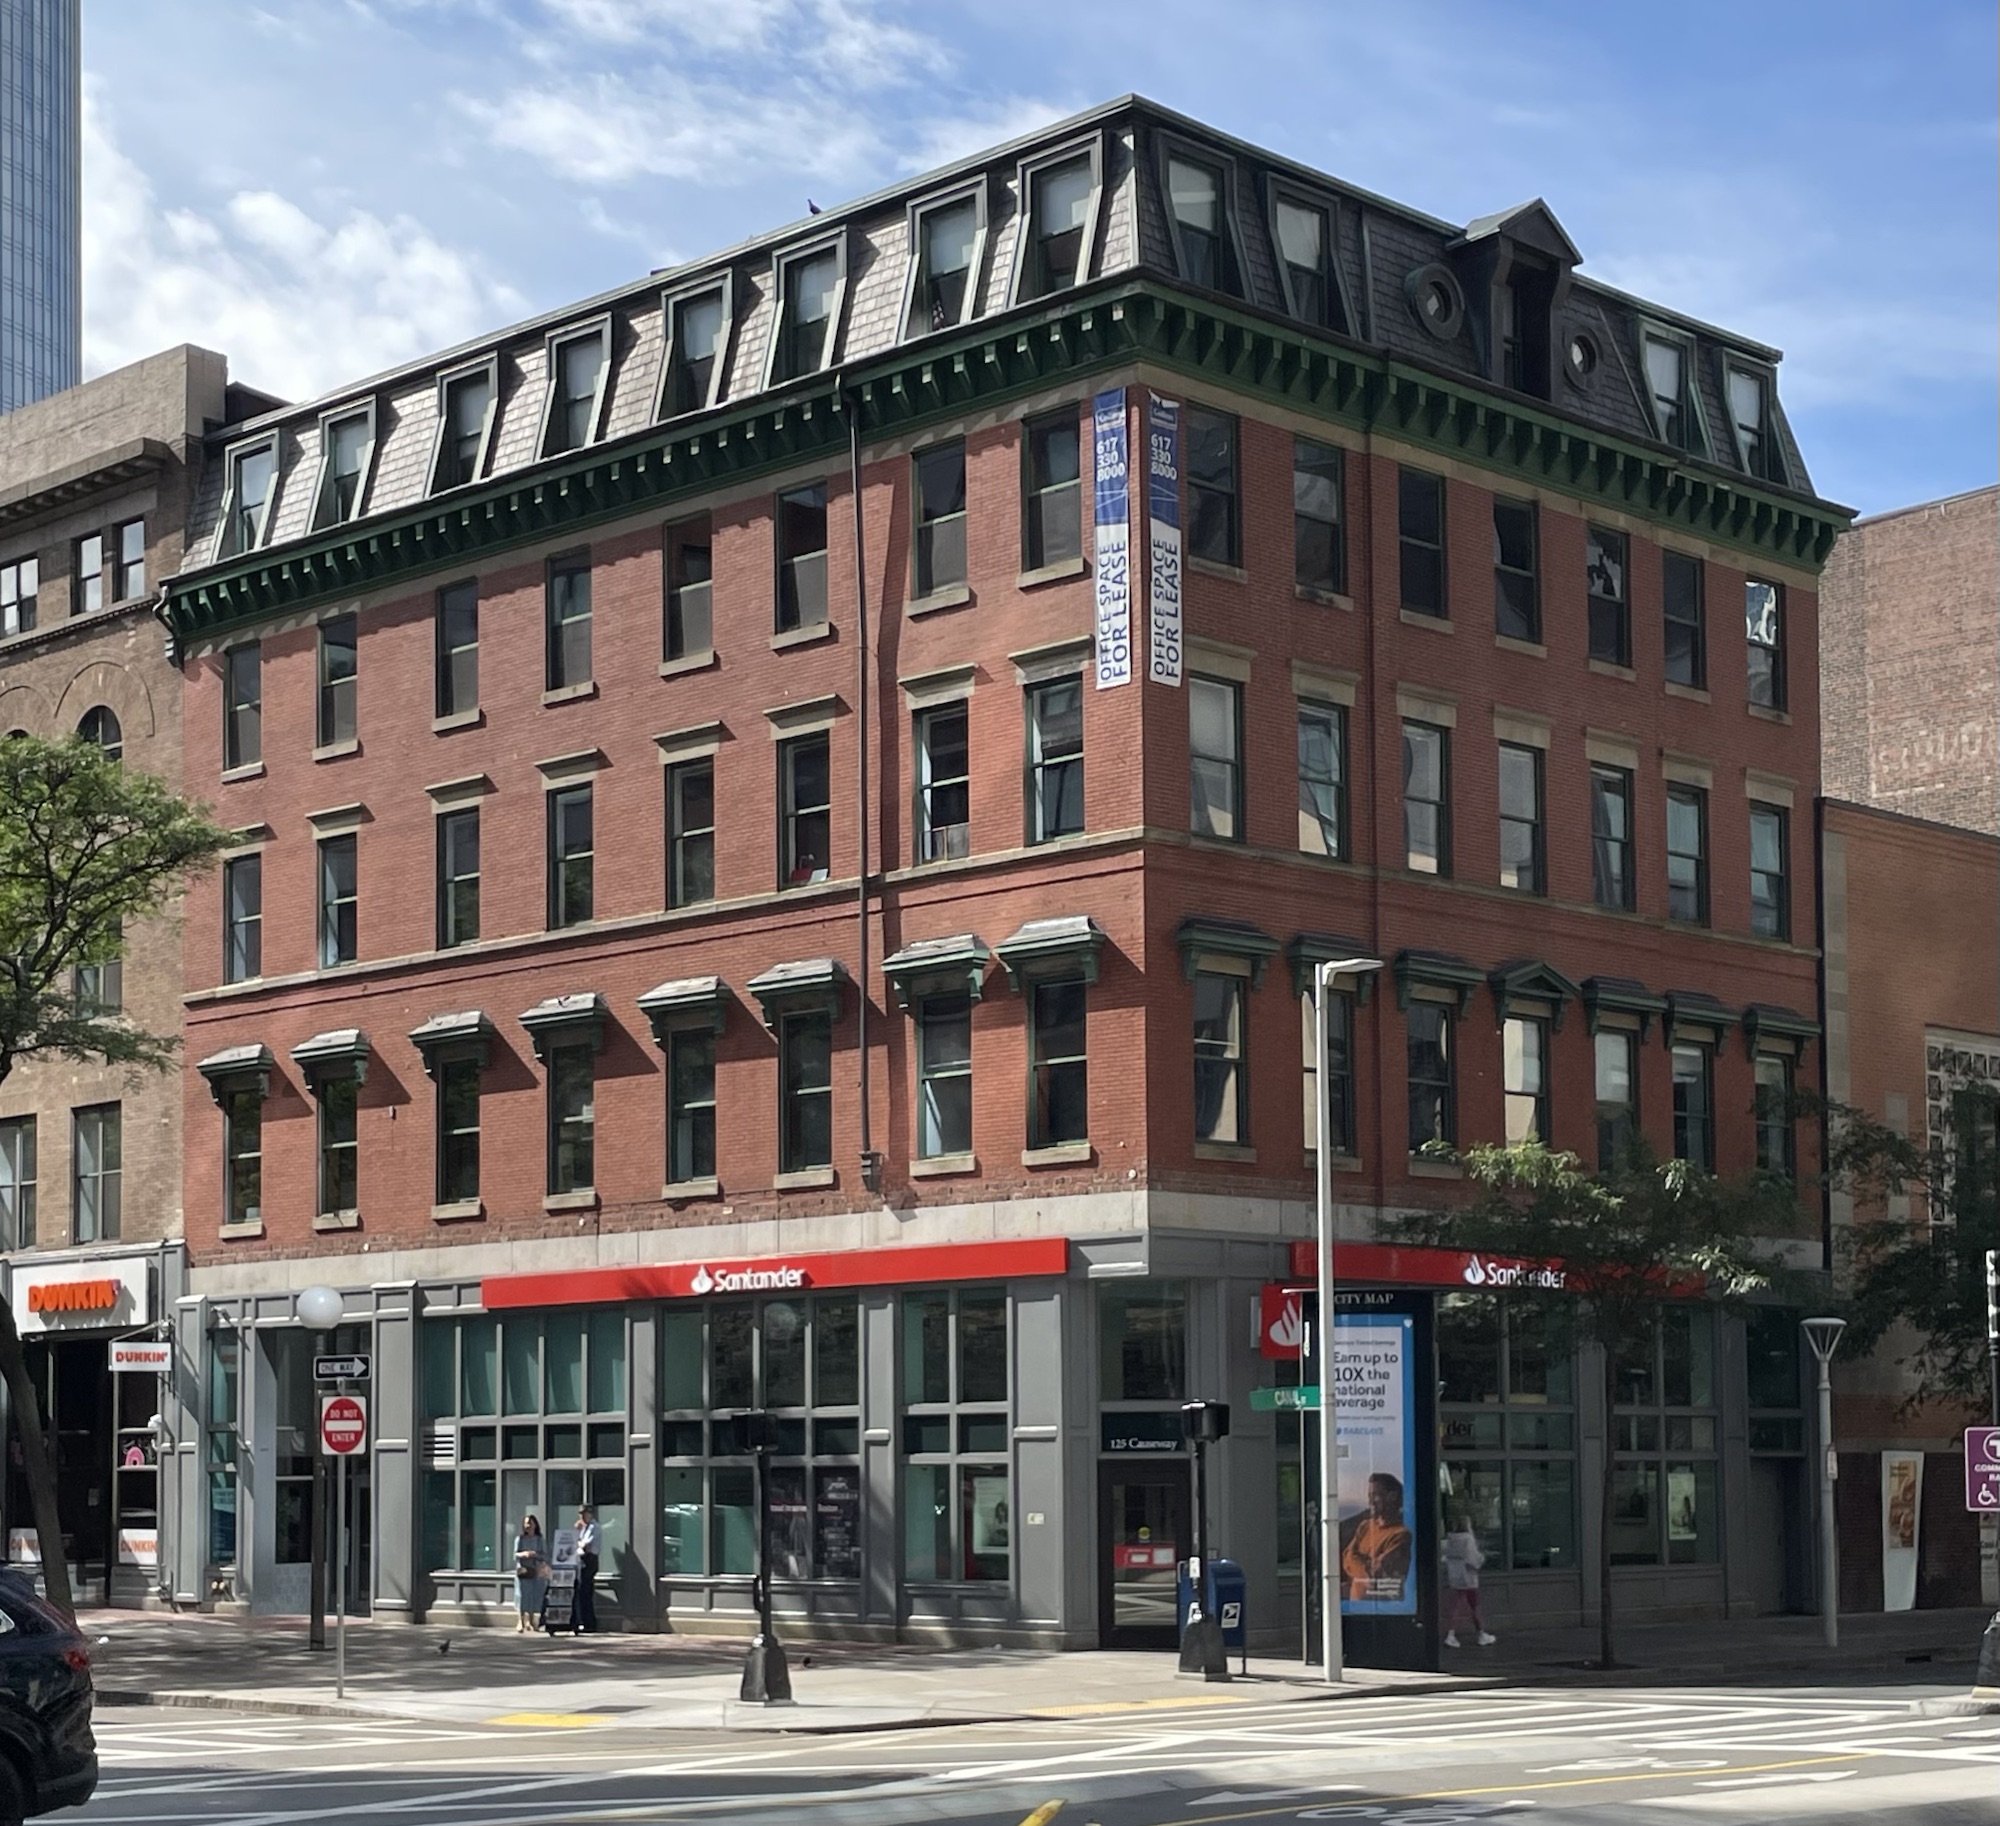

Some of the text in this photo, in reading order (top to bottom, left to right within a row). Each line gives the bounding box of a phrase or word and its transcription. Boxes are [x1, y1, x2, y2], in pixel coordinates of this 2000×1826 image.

[1097, 437, 1118, 454] 617
[1151, 433, 1171, 450] 617
[1097, 451, 1118, 468] 330
[1151, 447, 1171, 464] 330
[1097, 462, 1125, 482] 8000
[1151, 461, 1177, 480] 8000
[1100, 543, 1112, 681] OFFICE SPACE
[1111, 541, 1127, 678] FOR LEASE
[1153, 538, 1166, 676] OFFICE SPACE
[1164, 541, 1179, 679] FOR LEASE
[714, 1265, 805, 1292] Santander
[28, 1279, 121, 1312] DUNKIN'
[1334, 1293, 1394, 1304] CITY MAP
[115, 1351, 168, 1362] DUNKIN'
[1334, 1351, 1398, 1366] Earn up to
[320, 1363, 354, 1373] ONE WAY
[1334, 1366, 1390, 1381] 10X the
[329, 1408, 358, 1419] DO NOT
[331, 1432, 355, 1442] ENTER
[1110, 1437, 1178, 1451] 125 Causeway
